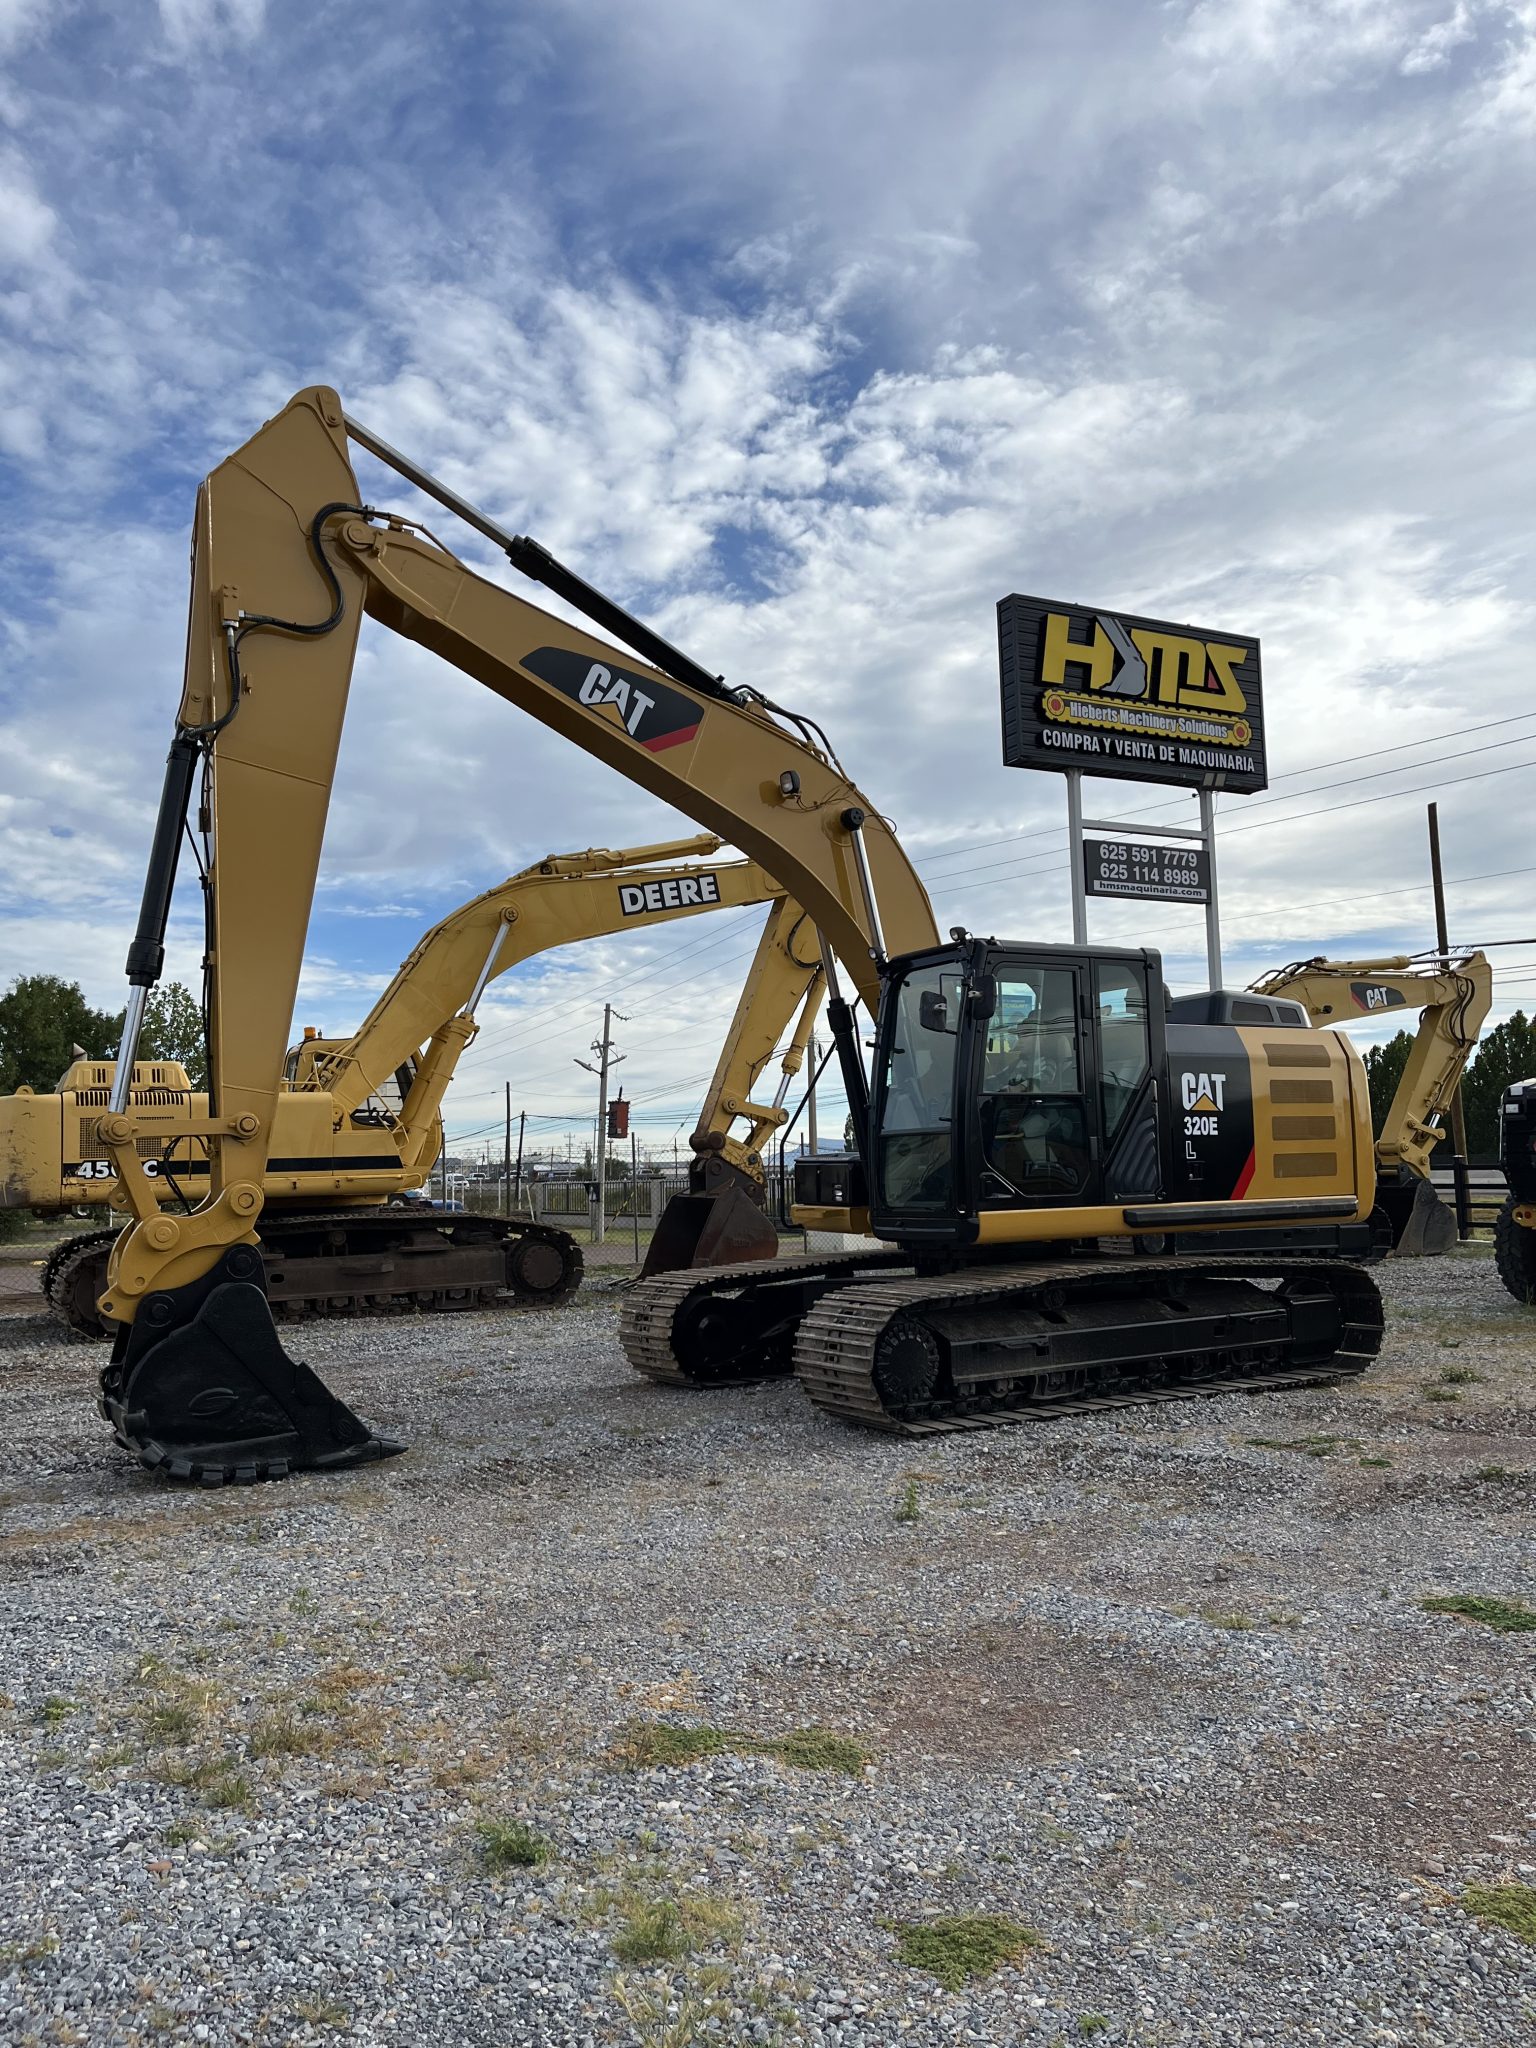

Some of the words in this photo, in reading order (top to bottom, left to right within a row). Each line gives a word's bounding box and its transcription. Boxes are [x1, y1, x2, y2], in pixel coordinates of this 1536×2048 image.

[579, 663, 656, 736] CAT
[1069, 701, 1118, 723] Hieberts
[1119, 710, 1177, 732] Machinery
[1178, 717, 1228, 738] Solutions
[1043, 729, 1100, 753] COMPRA
[1102, 738, 1112, 754] Y
[1115, 740, 1156, 759] VENTA
[1159, 745, 1176, 762] DE
[1179, 747, 1255, 772] MAQUINARIA
[1100, 844, 1128, 861] 625
[1131, 847, 1157, 863] 591
[1162, 850, 1197, 867] 7779
[1100, 863, 1128, 880] 625
[1133, 866, 1159, 882] 114
[1163, 868, 1199, 885] 8989
[621, 876, 718, 913] DEERE
[1100, 881, 1202, 897] hmsmaquinaria.com
[1366, 987, 1388, 1008] CAT
[1181, 1072, 1226, 1112] CAT
[1183, 1116, 1218, 1135] 320E
[1185, 1140, 1197, 1159] L
